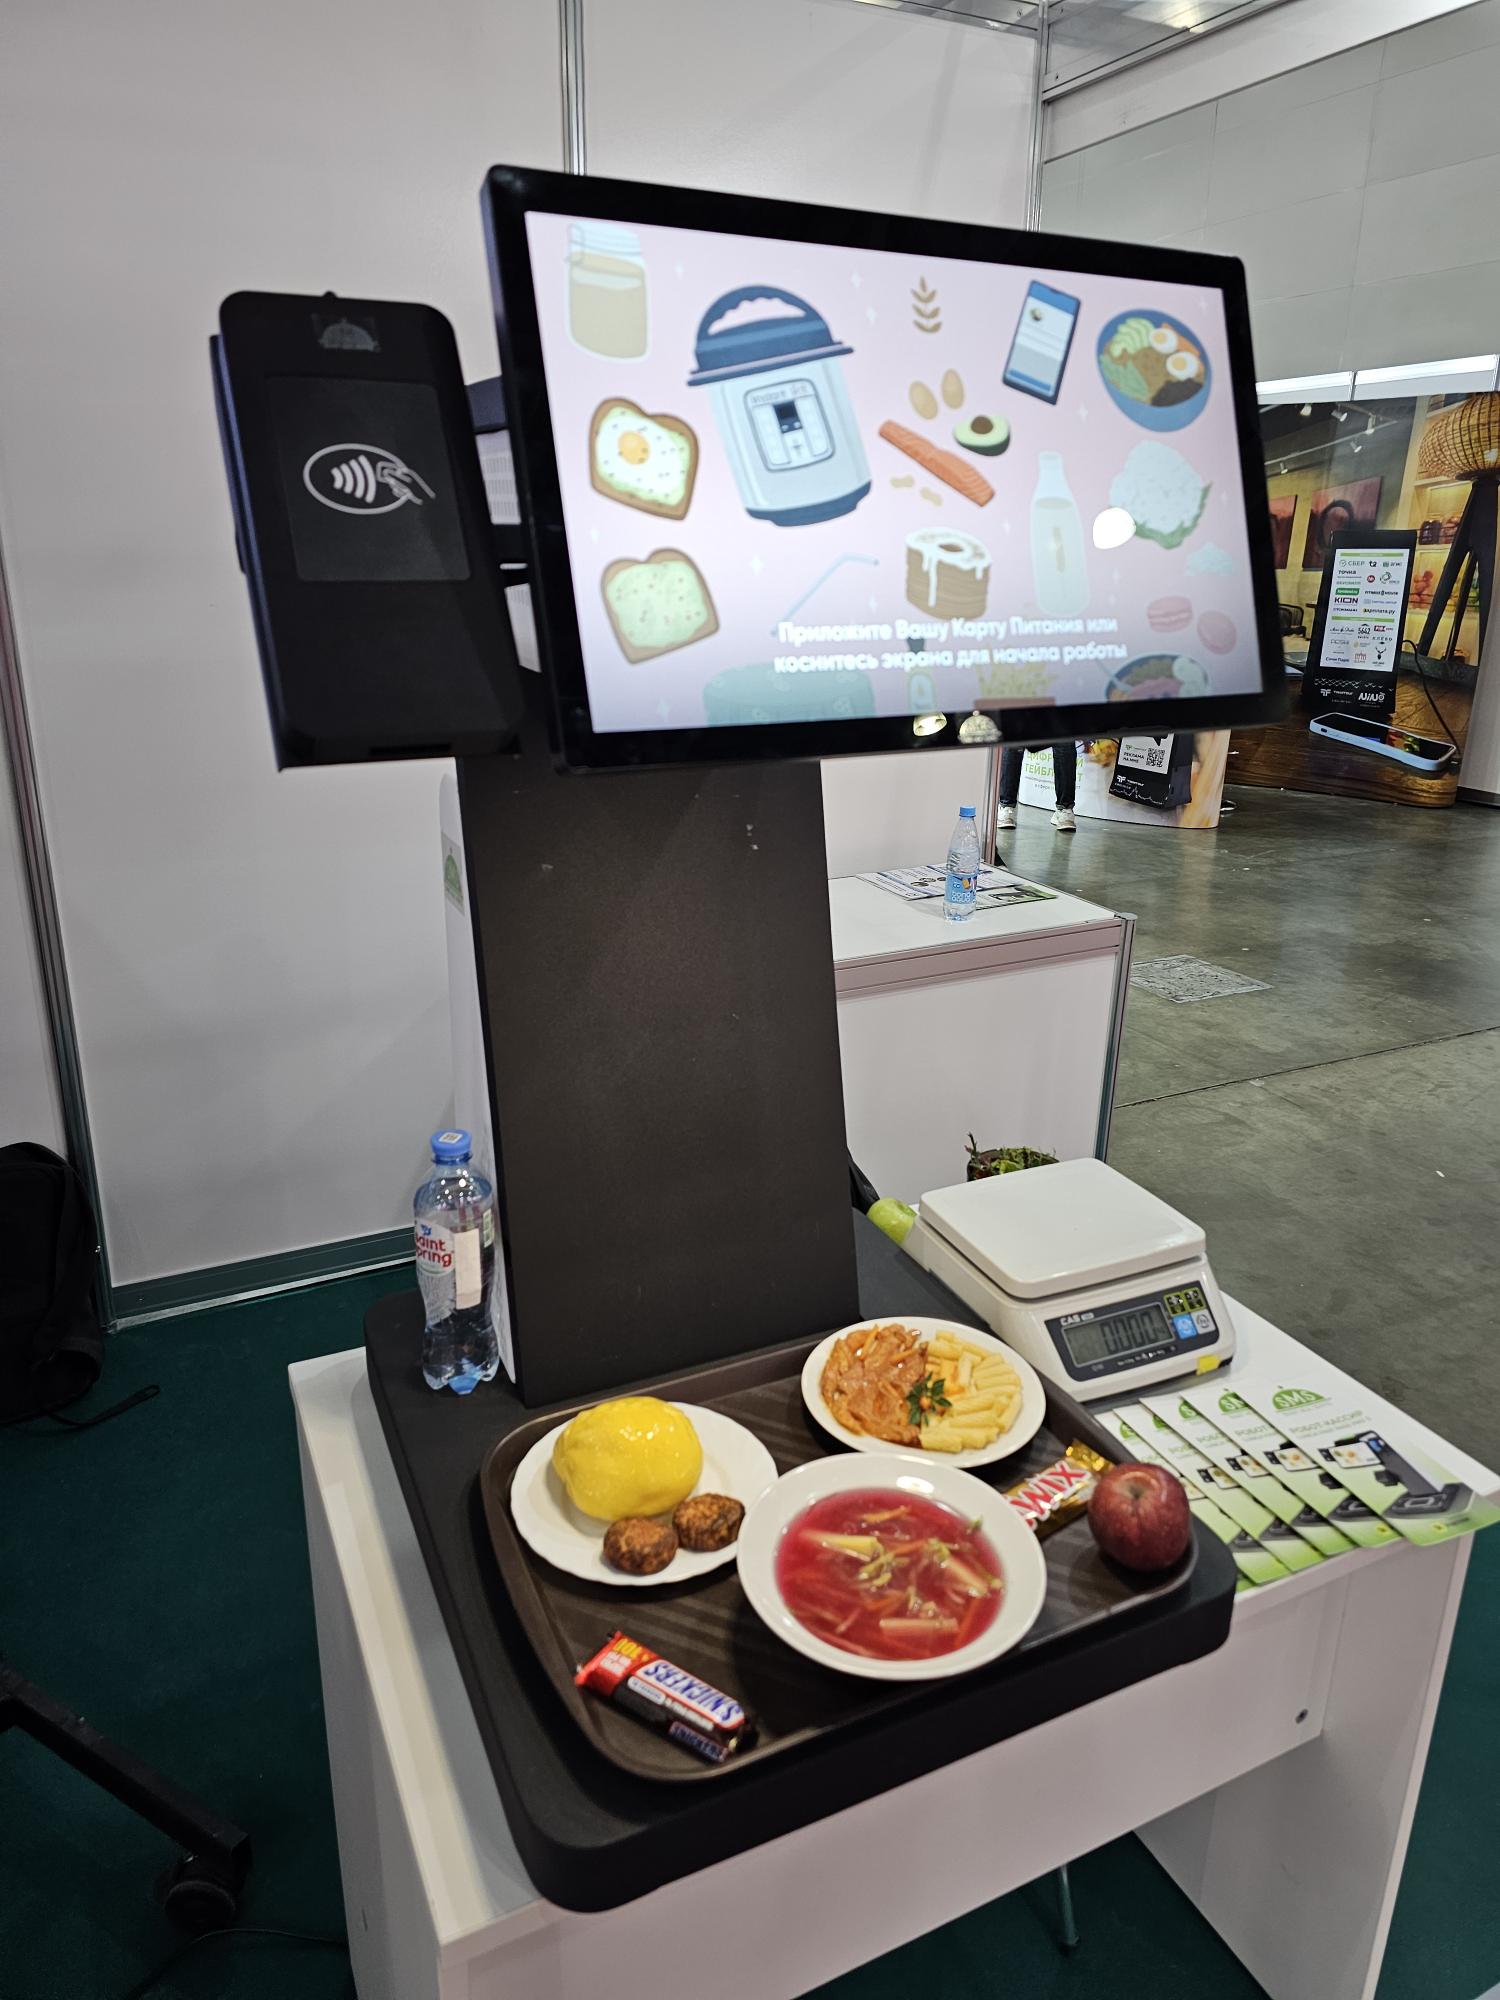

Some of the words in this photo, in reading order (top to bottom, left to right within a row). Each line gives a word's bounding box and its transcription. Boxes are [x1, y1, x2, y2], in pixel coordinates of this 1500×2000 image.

[778, 621, 893, 647] Приложите
[894, 619, 948, 642] Вашу
[950, 617, 1007, 642] Карту
[1008, 616, 1085, 636] Питания
[1086, 618, 1119, 633] или
[774, 654, 880, 674] коснитесь
[880, 651, 954, 673] экрана
[955, 649, 990, 669] для
[992, 646, 1061, 665] начала
[1061, 641, 1128, 666] работы
[414, 1246, 452, 1268] pring
[1060, 1314, 1081, 1326] CAS
[1274, 1388, 1310, 1406] SMS
[1010, 1462, 1088, 1529] WIX
[643, 1662, 741, 1722] SNICKERS
